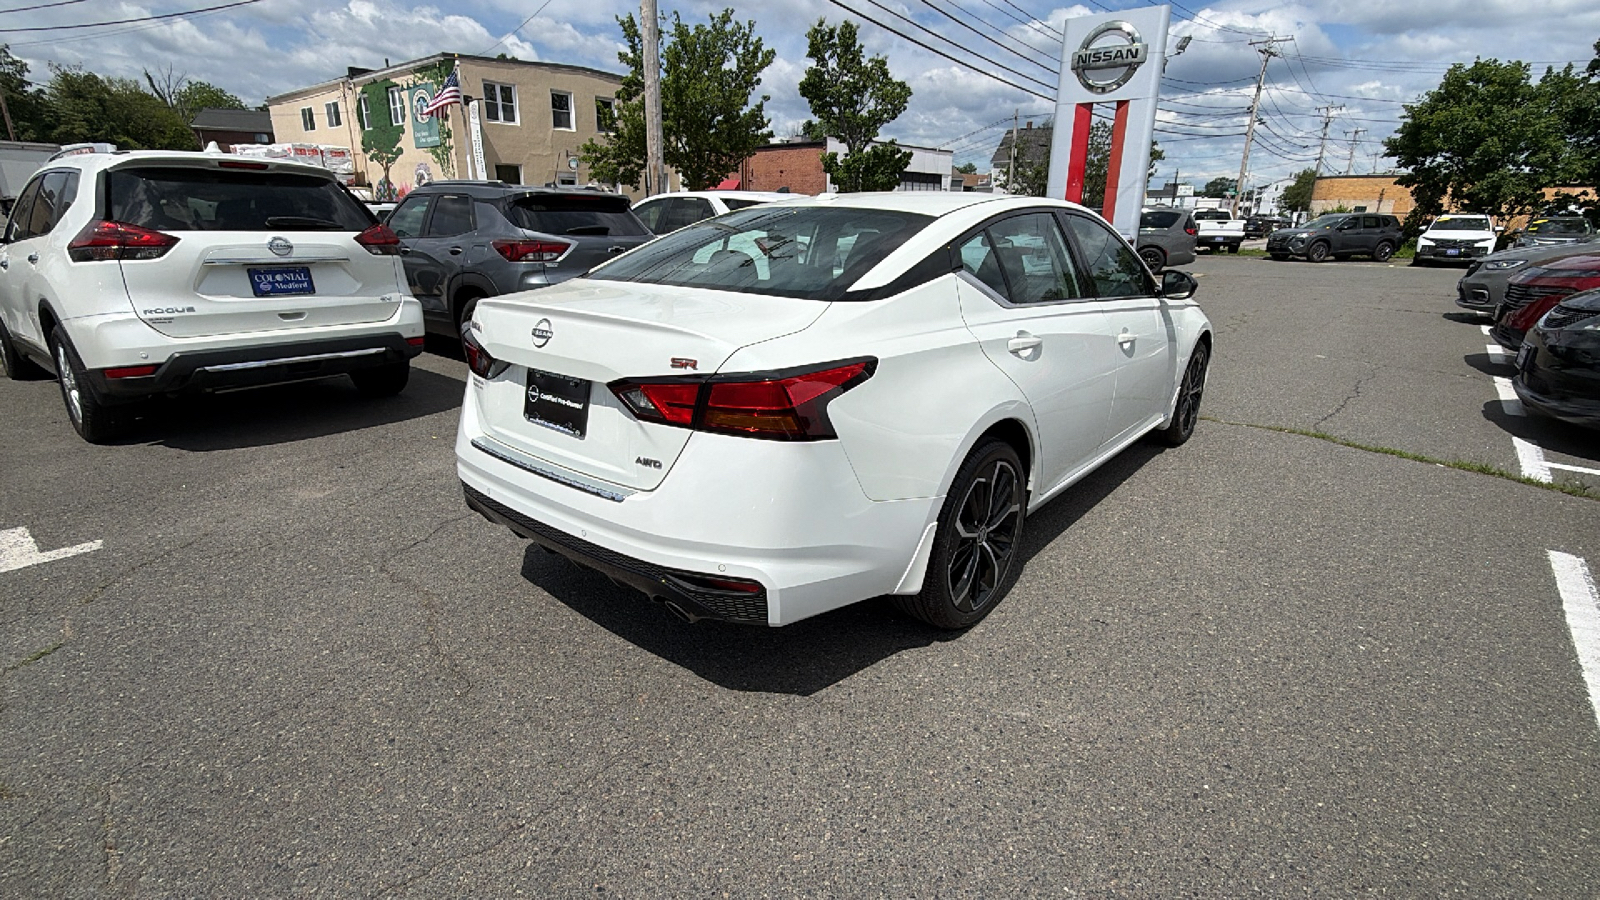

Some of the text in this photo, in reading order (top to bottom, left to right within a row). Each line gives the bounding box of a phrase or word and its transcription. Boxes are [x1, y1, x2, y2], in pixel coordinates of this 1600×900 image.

[1077, 48, 1139, 64] NISSAN
[254, 272, 309, 282] COLONIAL
[274, 281, 308, 290] Medford
[143, 306, 196, 315] ROGUE
[670, 357, 698, 370] SR
[635, 456, 663, 470] AWD
